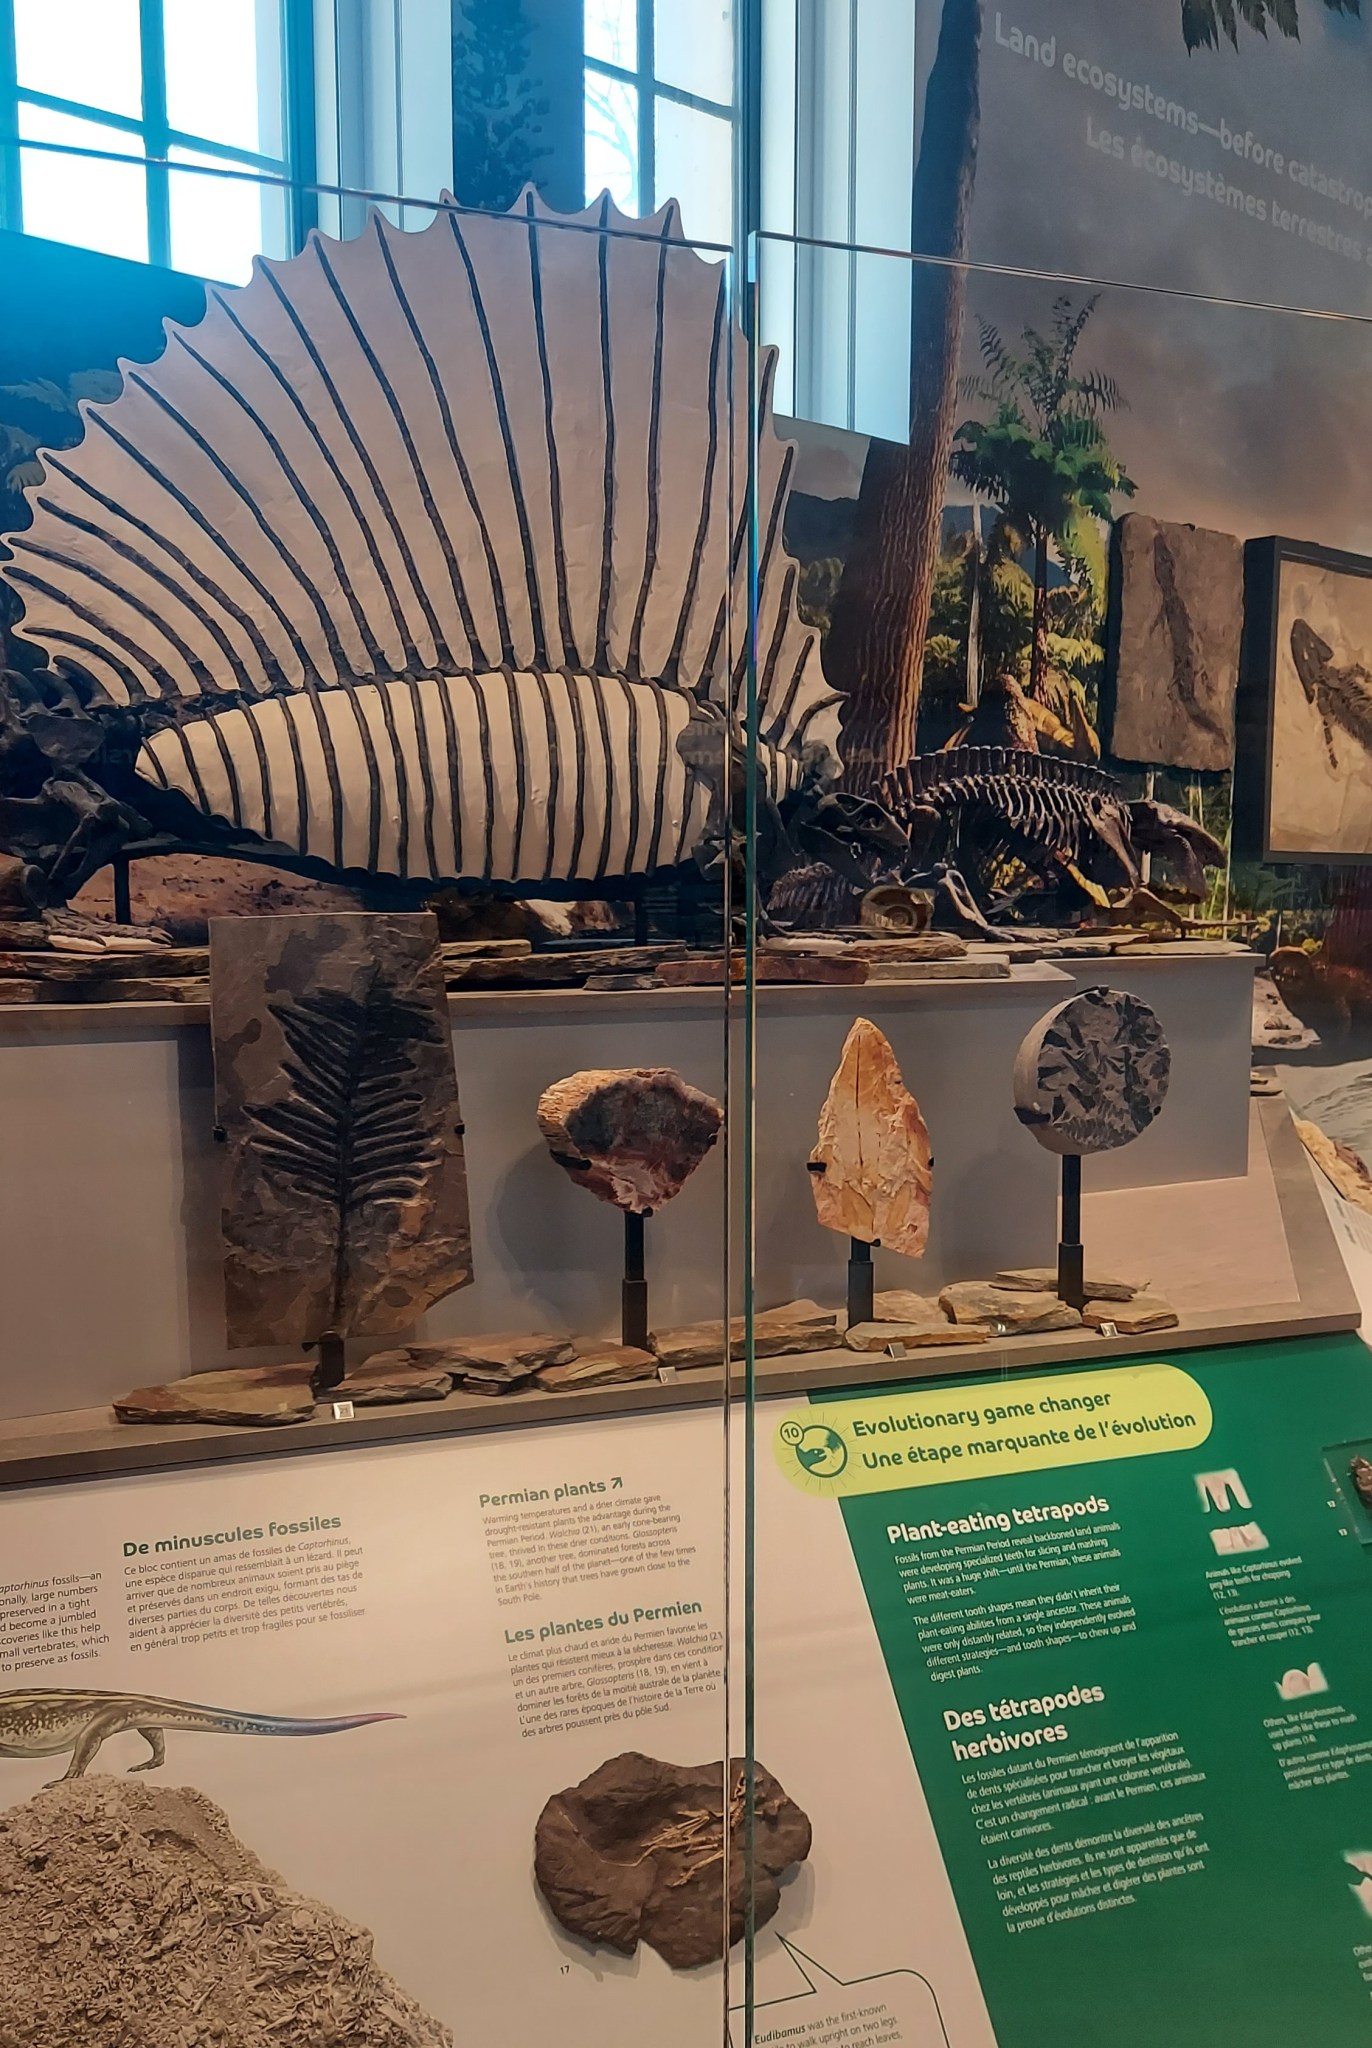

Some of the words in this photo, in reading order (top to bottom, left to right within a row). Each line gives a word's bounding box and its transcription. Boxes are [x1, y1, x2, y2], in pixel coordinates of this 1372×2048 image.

[995, 11, 1057, 68] Land
[1086, 116, 1124, 160] Les
[1131, 137, 1267, 222] écosystèmes
[1272, 200, 1362, 261] terrestres
[851, 1409, 980, 1437] Evolutionary
[982, 1402, 1035, 1424] game
[1038, 1393, 1111, 1413] changer
[784, 1427, 799, 1439] 10
[861, 1452, 903, 1469] Une
[907, 1444, 963, 1463] étape
[966, 1429, 1070, 1455] marquante
[1073, 1425, 1097, 1441] de
[1098, 1413, 1196, 1437] l'évolution
[478, 1487, 550, 1508] Permian
[553, 1480, 606, 1502] plants
[481, 1513, 519, 1524] Warming
[519, 1506, 571, 1519] temperatures
[572, 1501, 588, 1513] and
[588, 1503, 594, 1511] a
[595, 1499, 612, 1510] drier
[614, 1496, 642, 1507] climate
[642, 1494, 661, 1505] gave
[122, 1541, 149, 1557] De
[154, 1525, 263, 1553] minuscules
[268, 1515, 341, 1536] fossiles
[484, 1520, 551, 1536] drought-resistant
[552, 1517, 576, 1529] plants
[576, 1514, 590, 1524] the
[591, 1509, 631, 1521] advantage
[632, 1505, 657, 1516] during
[657, 1503, 671, 1512] the
[886, 1512, 1011, 1544] Plant-eating
[1011, 1495, 1109, 1524] tetrapods
[894, 1552, 920, 1564] Fossils
[919, 1550, 940, 1560] from
[939, 1547, 954, 1557] the
[953, 1543, 986, 1555] Permian
[985, 1537, 1011, 1550] Period
[1010, 1533, 1034, 1546] reveal
[1032, 1527, 1075, 1542] backboned
[1073, 1524, 1092, 1536] land
[1092, 1521, 1121, 1533] animals
[124, 1566, 137, 1576] Ce
[136, 1563, 158, 1574] bloc
[159, 1557, 197, 1571] contient
[198, 1556, 211, 1565] un
[212, 1552, 236, 1563] amas
[238, 1549, 250, 1559] de
[251, 1546, 283, 1557] fossiles
[284, 1543, 296, 1553] de
[125, 1579, 142, 1588] une
[144, 1573, 176, 1586] espèce
[177, 1568, 216, 1580] disparue
[217, 1563, 232, 1576] qui
[234, 1557, 283, 1572] ressemblait
[285, 1556, 291, 1565] à
[292, 1555, 305, 1564] un
[336, 1549, 342, 1557] Il
[343, 1546, 363, 1557] peut
[30, 1591, 55, 1602] large
[56, 1585, 98, 1598] numbers
[125, 1589, 155, 1601] arriver
[156, 1586, 175, 1598] que
[176, 1583, 188, 1593] de
[190, 1577, 236, 1590] nombreux
[237, 1572, 275, 1584] animaux
[276, 1567, 304, 1578] soient
[305, 1565, 321, 1576] pris
[322, 1563, 334, 1571] au
[335, 1560, 359, 1571] piège
[47, 1602, 57, 1612] in
[59, 1602, 65, 1610] a
[67, 1597, 90, 1610] tight
[906, 1594, 927, 1605] were
[8, 1618, 47, 1631] become
[49, 1617, 56, 1625] a
[57, 1608, 96, 1626] jumbled
[41, 1628, 59, 1639] like
[60, 1625, 78, 1636] this
[79, 1622, 101, 1633] help
[503, 1628, 535, 1643] Les
[538, 1617, 604, 1642] plantes
[607, 1610, 629, 1626] du
[632, 1600, 702, 1623] Permien
[80, 1633, 110, 1646] which
[507, 1653, 518, 1662] Le
[519, 1648, 544, 1660] climat
[545, 1645, 563, 1658] plus
[563, 1639, 589, 1653] chaud
[589, 1639, 599, 1648] et
[600, 1635, 620, 1647] aride
[620, 1632, 632, 1643] du
[633, 1629, 665, 1641] Permien
[665, 1624, 697, 1635] favorise
[696, 1620, 708, 1630] les
[0, 1663, 12, 1672] to
[13, 1656, 55, 1672] preserve
[56, 1654, 68, 1663] as
[930, 1668, 956, 1682] digest
[516, 1699, 551, 1712] dominer
[552, 1696, 565, 1705] les
[565, 1691, 590, 1703] forêts
[590, 1688, 602, 1699] de
[602, 1687, 611, 1696] la
[611, 1681, 637, 1695] moitié
[638, 1676, 670, 1690] australe
[670, 1674, 682, 1685] de
[681, 1672, 690, 1682] la
[690, 1668, 721, 1684] planète
[521, 1727, 536, 1738] des
[537, 1722, 564, 1735] arbres
[564, 1715, 602, 1732] poussent
[603, 1711, 621, 1724] près
[621, 1709, 633, 1719] du
[634, 1705, 652, 1719] pôle
[942, 1708, 986, 1731] Des
[987, 1684, 1105, 1721] tétrapodes
[951, 1724, 1068, 1761] herbivores
[560, 1965, 570, 1975] 17
[755, 2025, 806, 2045] Eudibamus
[807, 2020, 824, 2030] was
[825, 2014, 840, 2026] the
[841, 2004, 887, 2022] first-known
[797, 2036, 817, 2048] walk
[818, 2029, 848, 2045] upright
[850, 2026, 861, 2034] on
[863, 2021, 878, 2030] two
